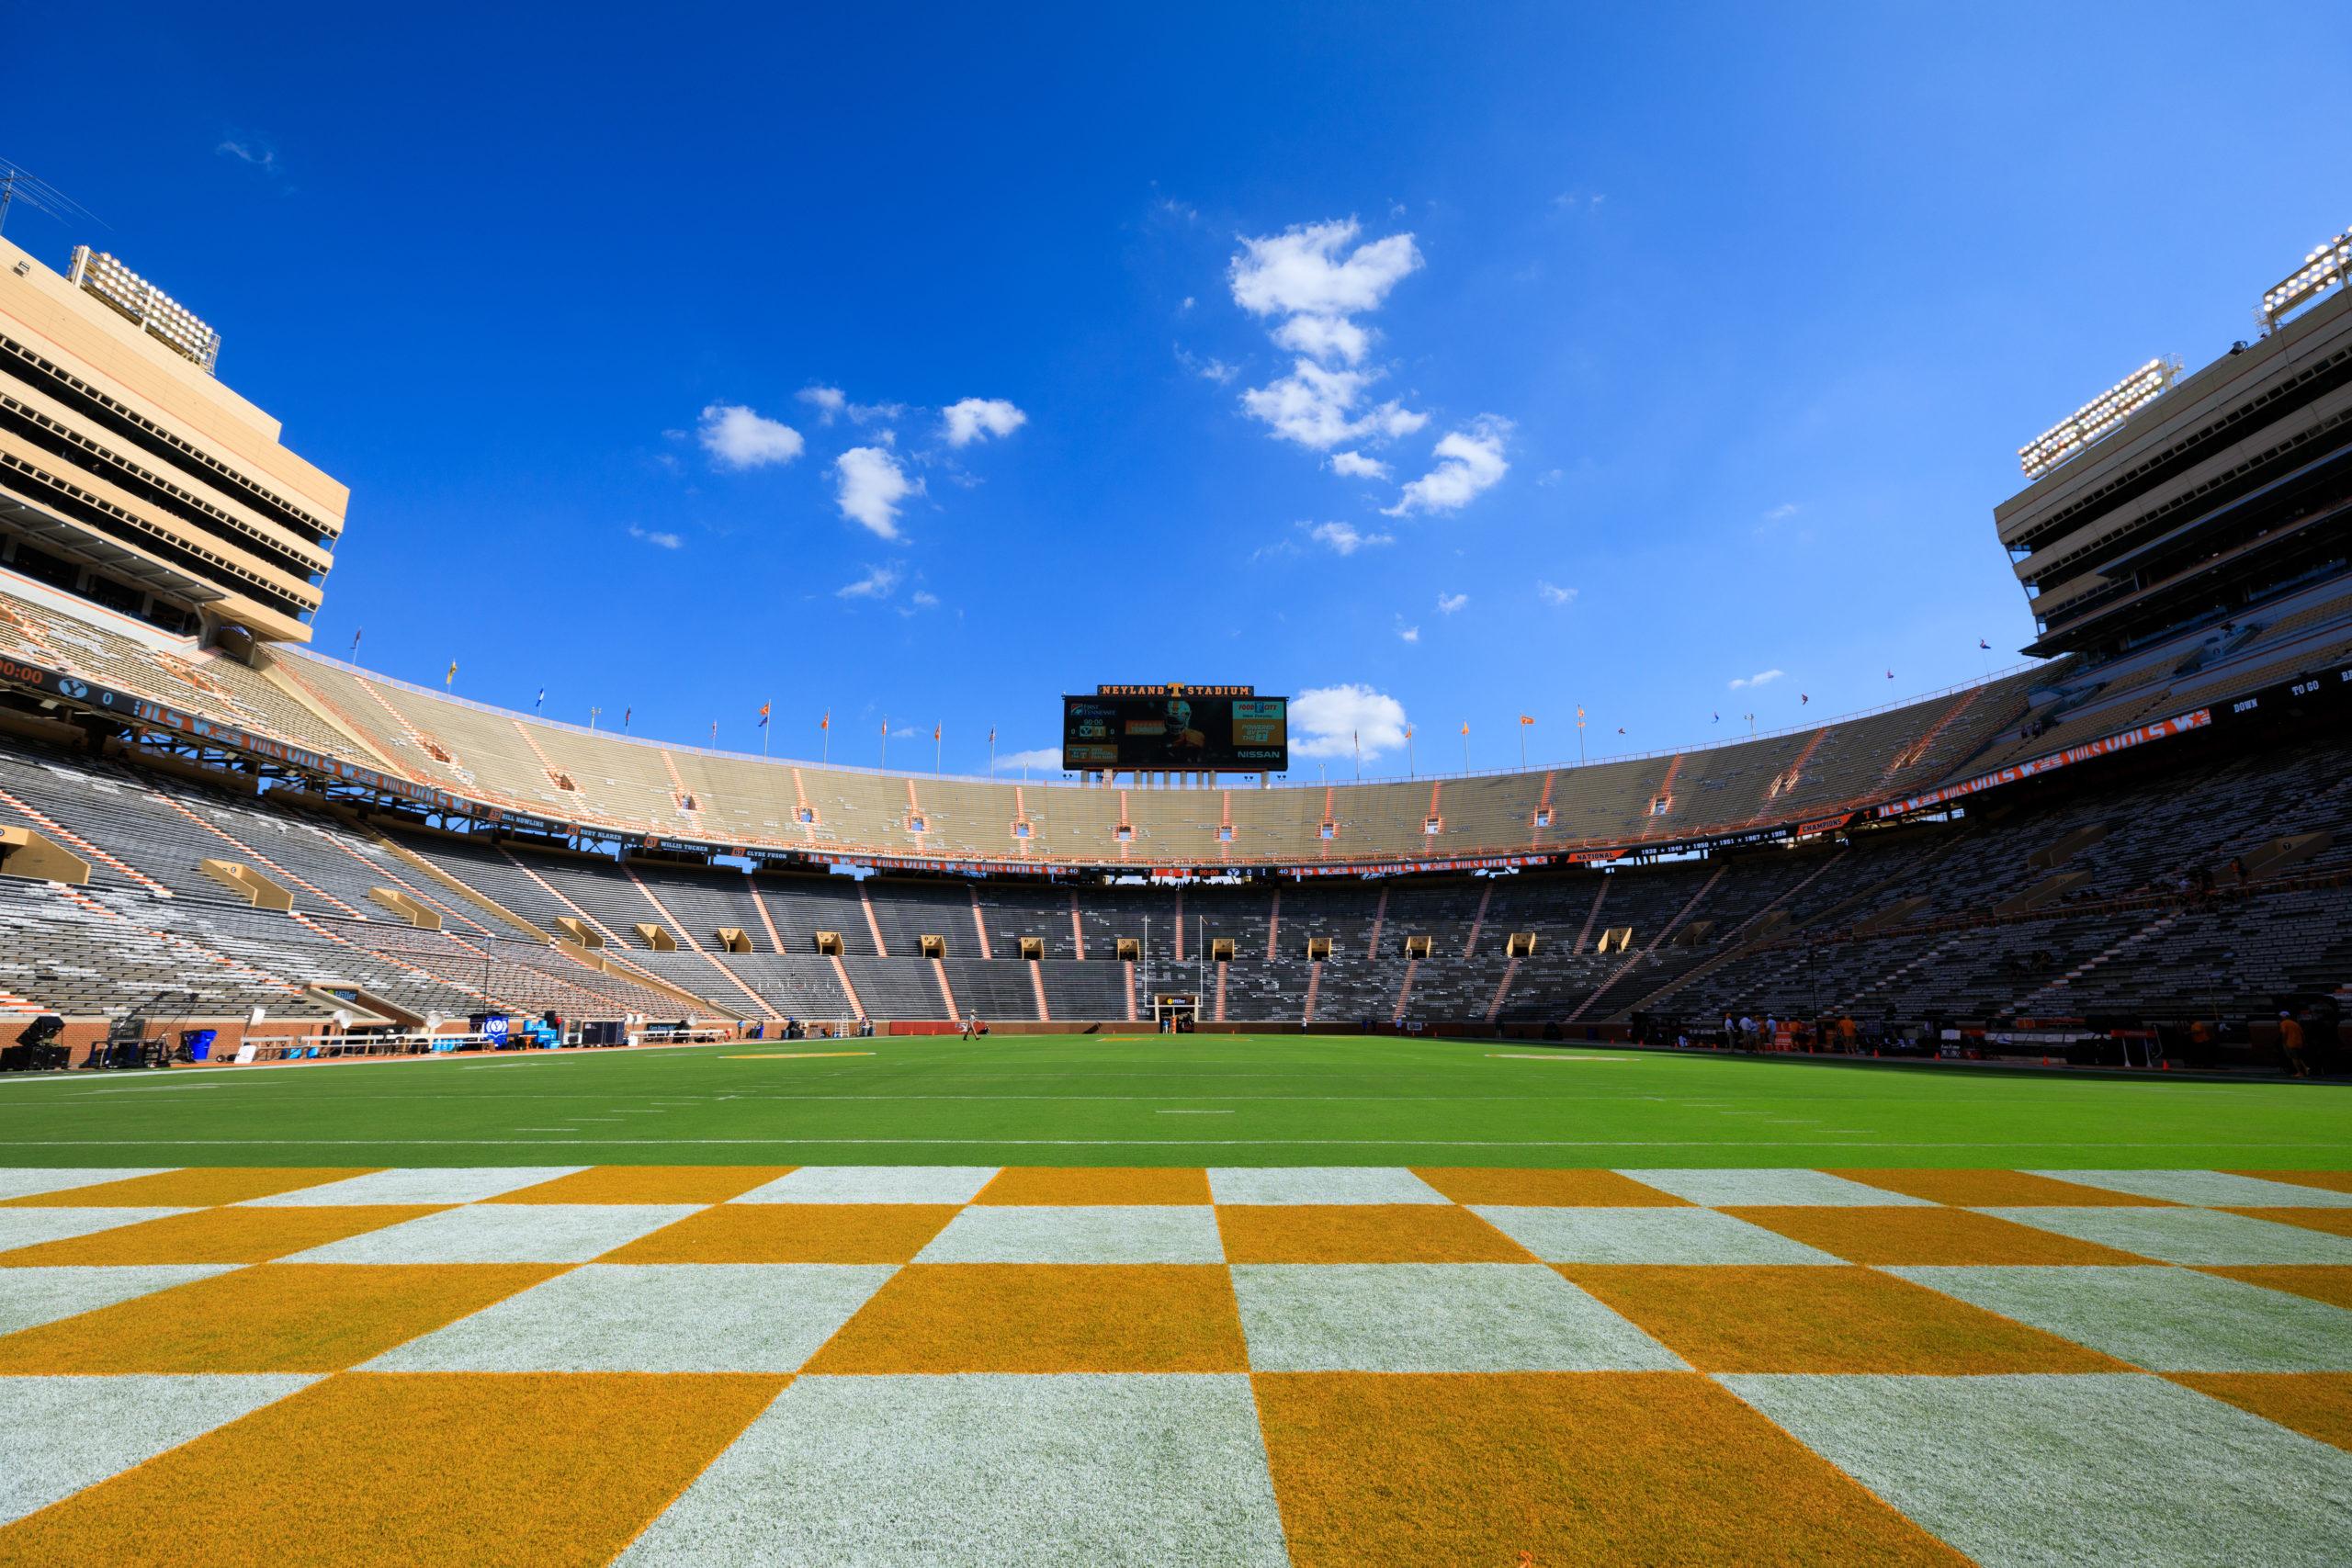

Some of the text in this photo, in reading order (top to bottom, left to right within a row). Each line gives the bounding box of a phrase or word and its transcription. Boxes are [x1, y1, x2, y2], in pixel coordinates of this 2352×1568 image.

[0, 661, 43, 684] 0:00
[102, 692, 114, 705] 0
[1102, 682, 1250, 697] NEYLAND T STADIUM
[2291, 680, 2319, 695] TO GO
[2233, 698, 2258, 713] DOWN
[2066, 722, 2165, 763] VOLS VOLS
[249, 735, 283, 759] VOLS
[286, 748, 336, 774] VOLS
[410, 784, 448, 808] VOLS
[1971, 768, 2015, 793] VOLS
[474, 806, 481, 815] T
[502, 813, 515, 822] BILL
[1803, 818, 1842, 832] CHAMPIONS
[661, 840, 683, 849] WILLIS
[684, 844, 708, 852] TUCKER
[1577, 852, 1614, 861] NATIONAL
[903, 860, 941, 870] VOLS
[1006, 864, 1042, 874] VOLS
[1378, 863, 1415, 874] VOLS
[1482, 857, 1521, 868] VOLS
[334, 990, 357, 1000] Hiller
